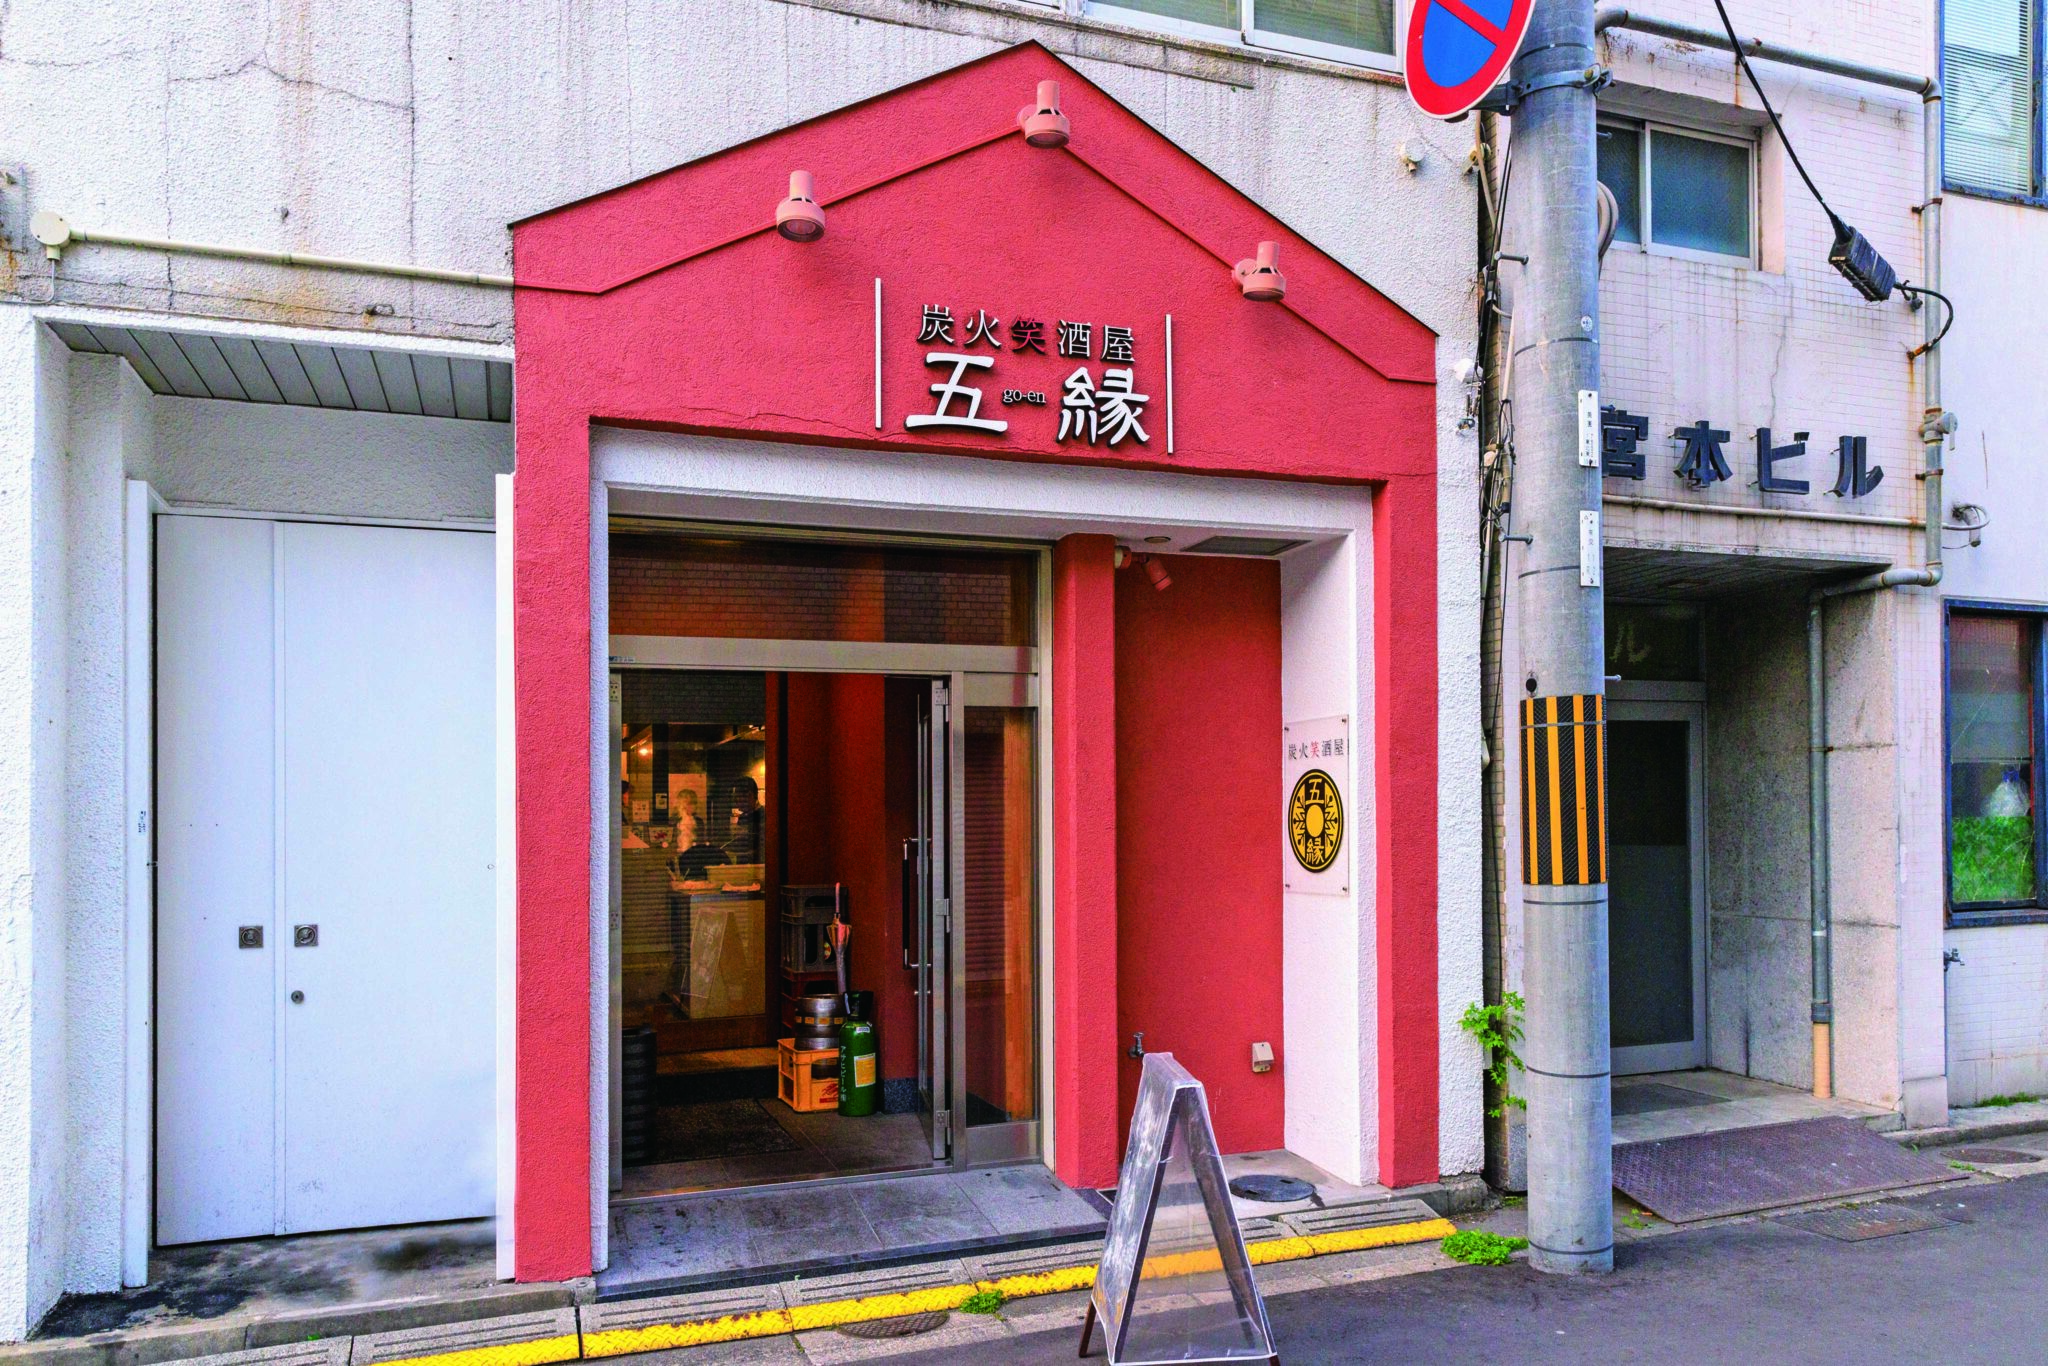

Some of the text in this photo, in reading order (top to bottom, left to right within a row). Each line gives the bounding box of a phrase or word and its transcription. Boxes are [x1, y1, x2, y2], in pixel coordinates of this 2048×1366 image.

[917, 303, 1135, 362] 炭火笑酒屋
[903, 352, 1150, 445] 五 縁
[1003, 388, 1046, 403] go-en
[1601, 409, 1884, 498] 宮本ビル
[1288, 738, 1344, 760] 炭火笑酒屋
